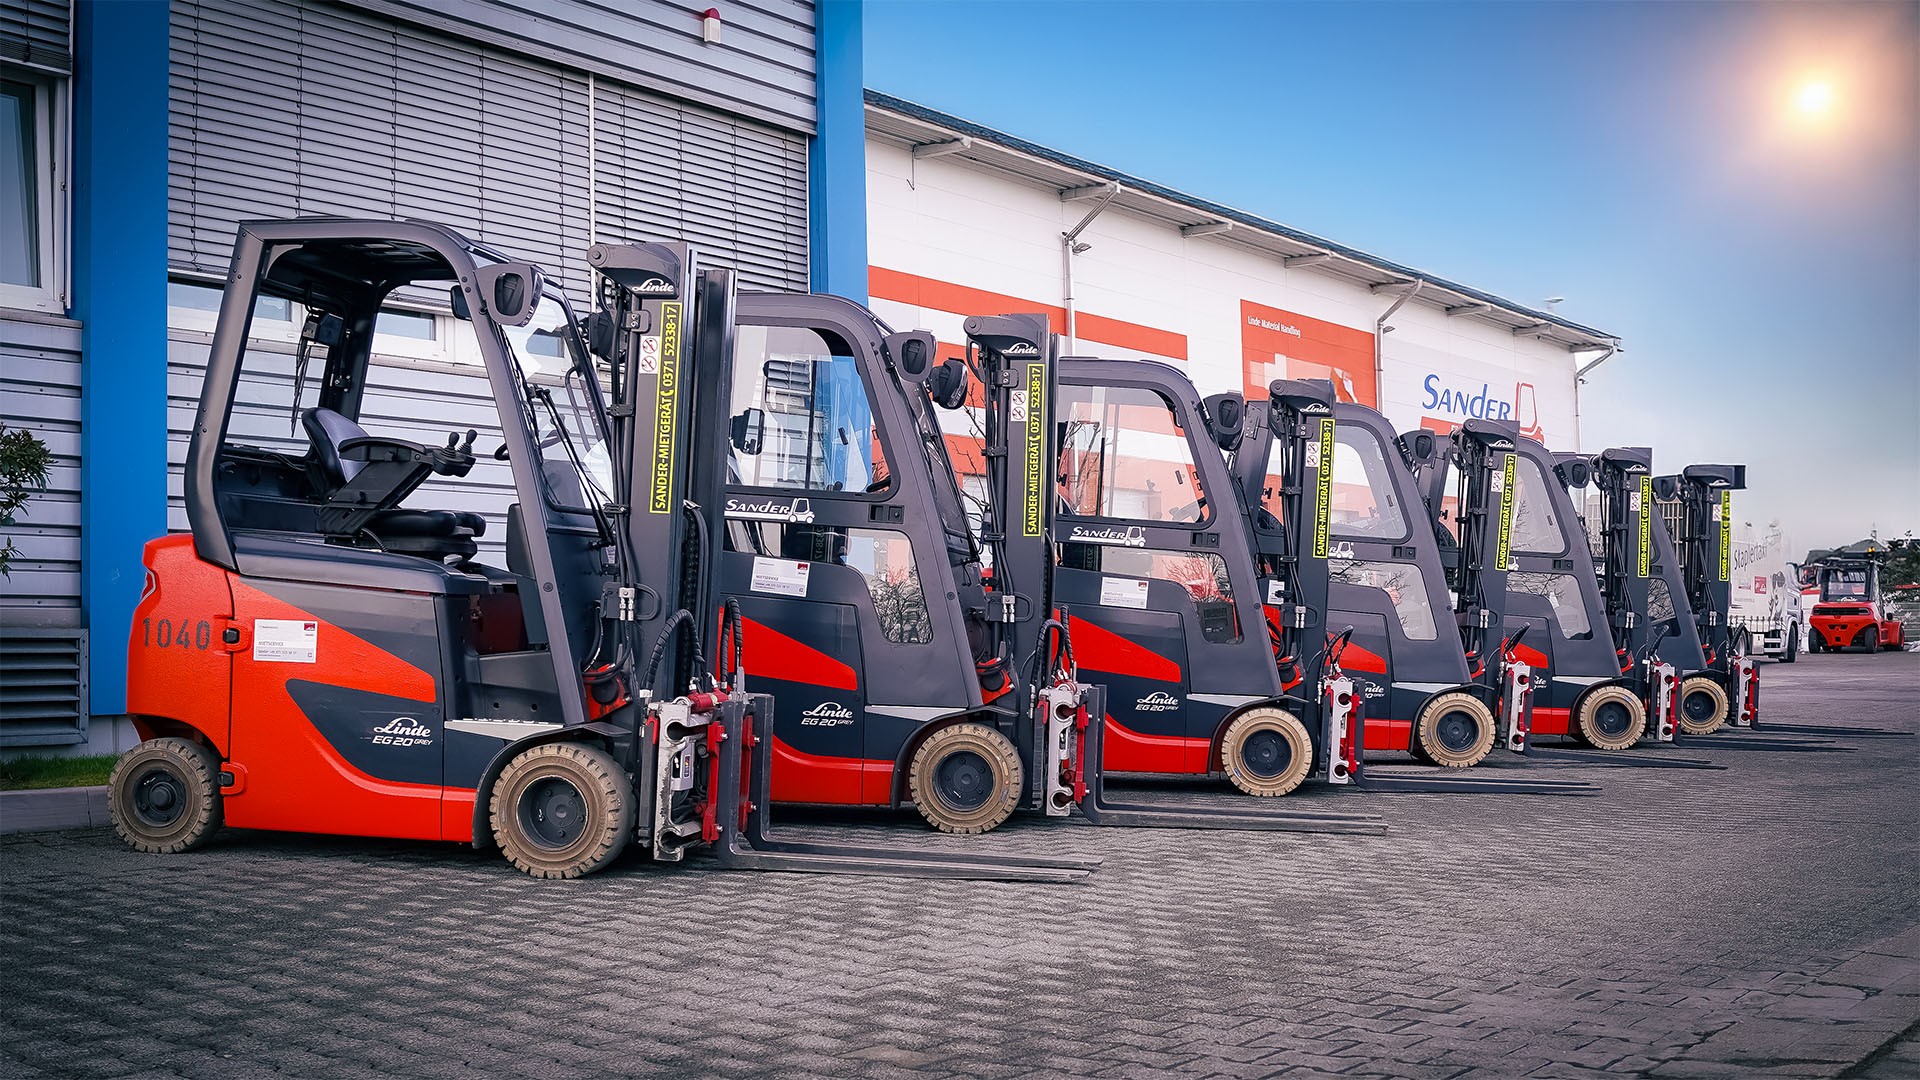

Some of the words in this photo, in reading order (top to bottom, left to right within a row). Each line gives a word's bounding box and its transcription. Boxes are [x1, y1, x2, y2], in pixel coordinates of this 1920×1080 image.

[632, 278, 674, 293] Linde
[666, 306, 679, 357] 52338-17
[1247, 316, 1261, 327] Linde
[1261, 319, 1281, 332] Material
[1281, 323, 1301, 339] Handling
[1001, 343, 1038, 355] Linde
[663, 360, 675, 387] 0371
[1032, 367, 1042, 408] 52338-17
[1300, 403, 1331, 413] Linde
[1031, 411, 1041, 433] 0371
[1489, 440, 1515, 449] Linde
[656, 398, 672, 510] SANDER-MIETGERÄT
[1321, 457, 1330, 475] 0371
[1028, 441, 1040, 533] SANDER-MIETGERÄT
[1317, 481, 1329, 555] SANDER-MIETGERÄT
[143, 617, 211, 651] 1040
[1365, 681, 1385, 693] nde
[1136, 691, 1179, 706] Linde
[802, 701, 853, 719] Linde
[1150, 704, 1165, 712] 20
[373, 716, 431, 737] Linde
[801, 717, 819, 726] EG
[818, 718, 837, 727] 20
[372, 735, 393, 745] EG
[392, 737, 414, 747] 20
